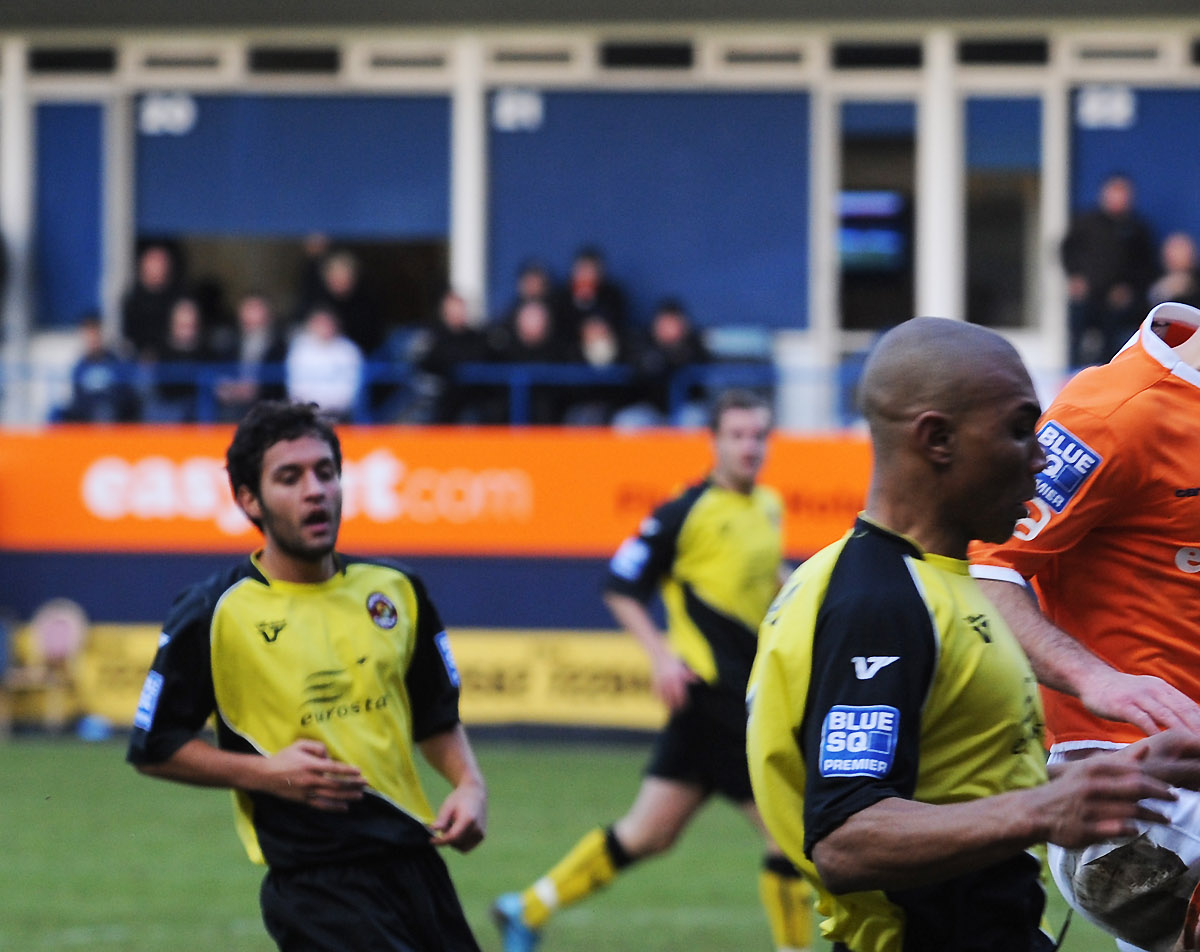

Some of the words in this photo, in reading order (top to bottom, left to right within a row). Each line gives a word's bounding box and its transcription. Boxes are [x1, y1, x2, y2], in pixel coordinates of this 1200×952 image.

[1037, 426, 1096, 475] BLUE
[1035, 478, 1065, 508] MIER
[300, 696, 391, 726] eurosta
[828, 711, 895, 732] BLUE
[825, 731, 869, 753] SQ
[823, 758, 888, 774] PREMIER
